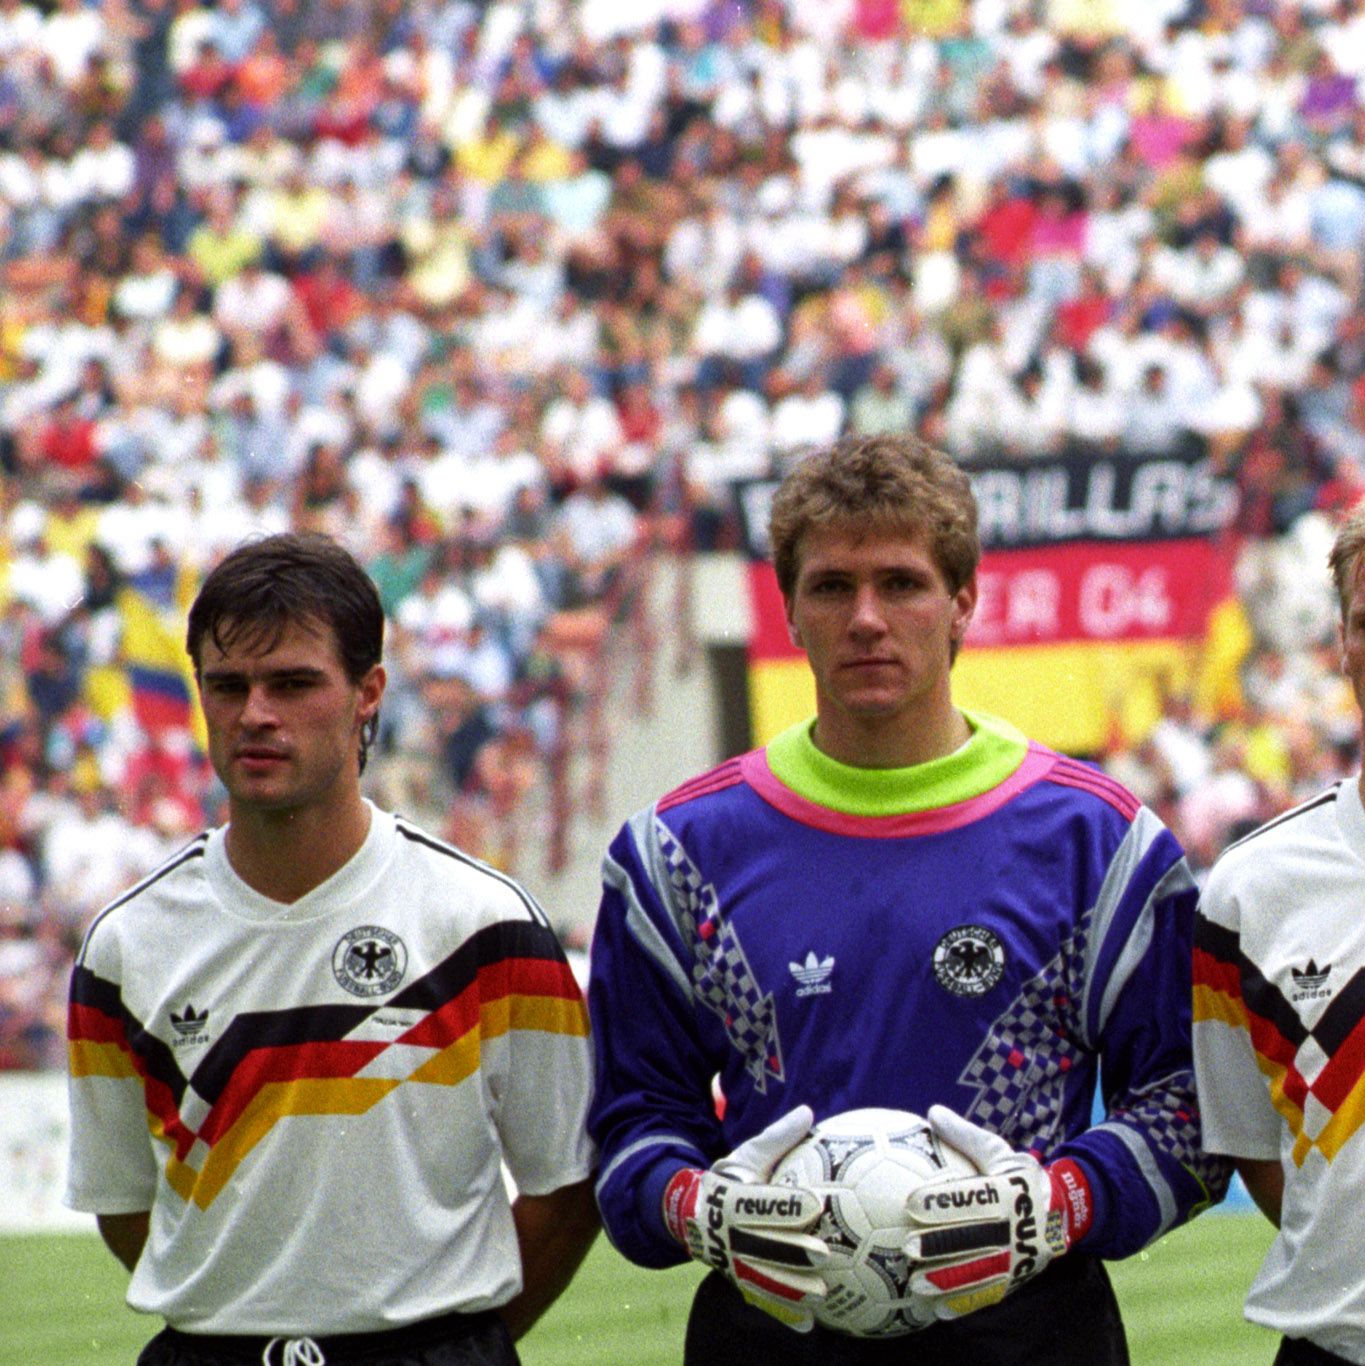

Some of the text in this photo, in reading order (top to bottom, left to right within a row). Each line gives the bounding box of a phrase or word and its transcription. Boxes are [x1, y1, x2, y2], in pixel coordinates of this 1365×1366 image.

[796, 983, 833, 997] adidas
[1292, 988, 1332, 1002] adidas
[735, 1194, 802, 1217] reusch
[924, 1183, 999, 1210] reusch
[706, 1185, 729, 1269] usch
[1008, 1176, 1038, 1285] reusc
